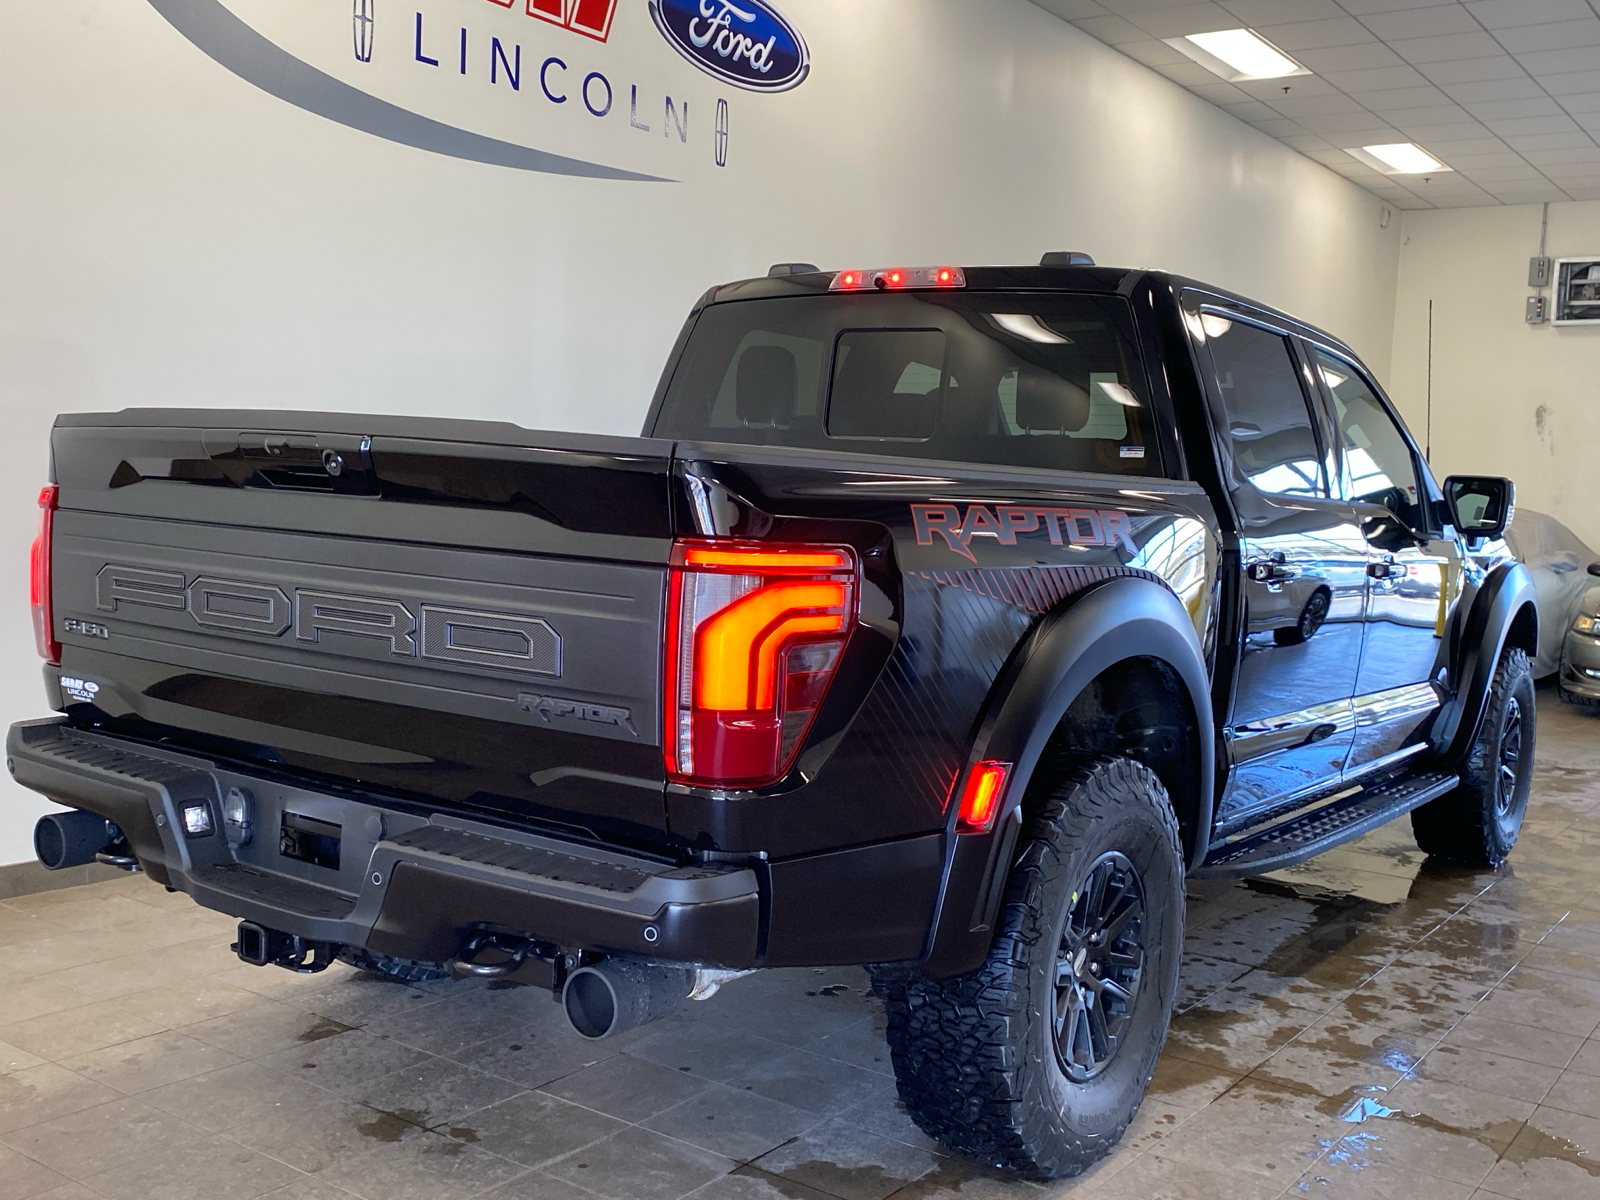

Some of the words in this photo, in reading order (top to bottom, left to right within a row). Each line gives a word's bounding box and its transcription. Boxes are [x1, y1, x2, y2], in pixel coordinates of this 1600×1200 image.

[689, 0, 776, 73] Ford
[415, 12, 688, 143] LINCOLN
[910, 503, 1144, 565] RAPTOR
[97, 563, 562, 678] FORD
[518, 692, 639, 737] RAPTOR
